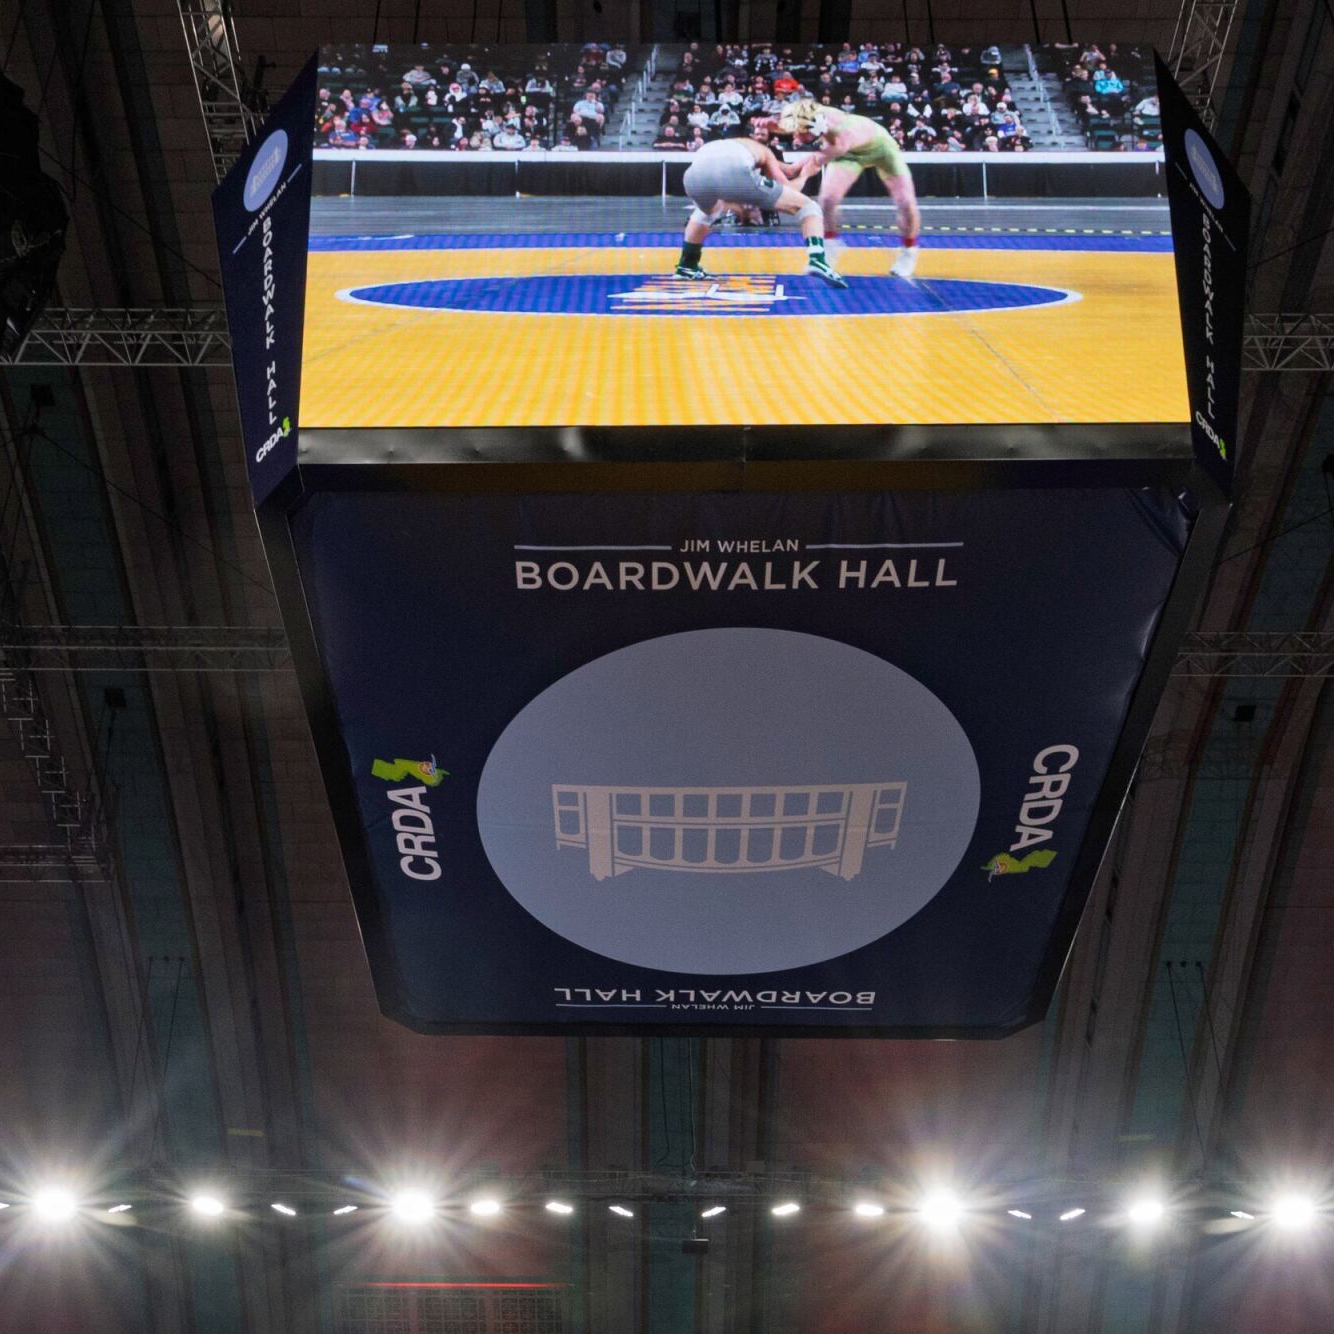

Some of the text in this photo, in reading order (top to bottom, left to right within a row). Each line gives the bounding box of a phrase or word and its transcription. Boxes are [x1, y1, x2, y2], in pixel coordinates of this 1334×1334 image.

[261, 215, 277, 425] BOARDWALK HALL
[1202, 212, 1216, 420] BOARDWALK HALL
[255, 426, 284, 464] CRDA
[1195, 409, 1220, 450] CRDA
[679, 538, 800, 553] JIM WHELAN
[514, 558, 959, 591] BOARDWALK HALL
[1009, 744, 1080, 852] CRDA
[387, 785, 443, 881] CRDA
[553, 987, 877, 1005] BOARDWALK HALL
[671, 1003, 729, 1011] WHELAN
